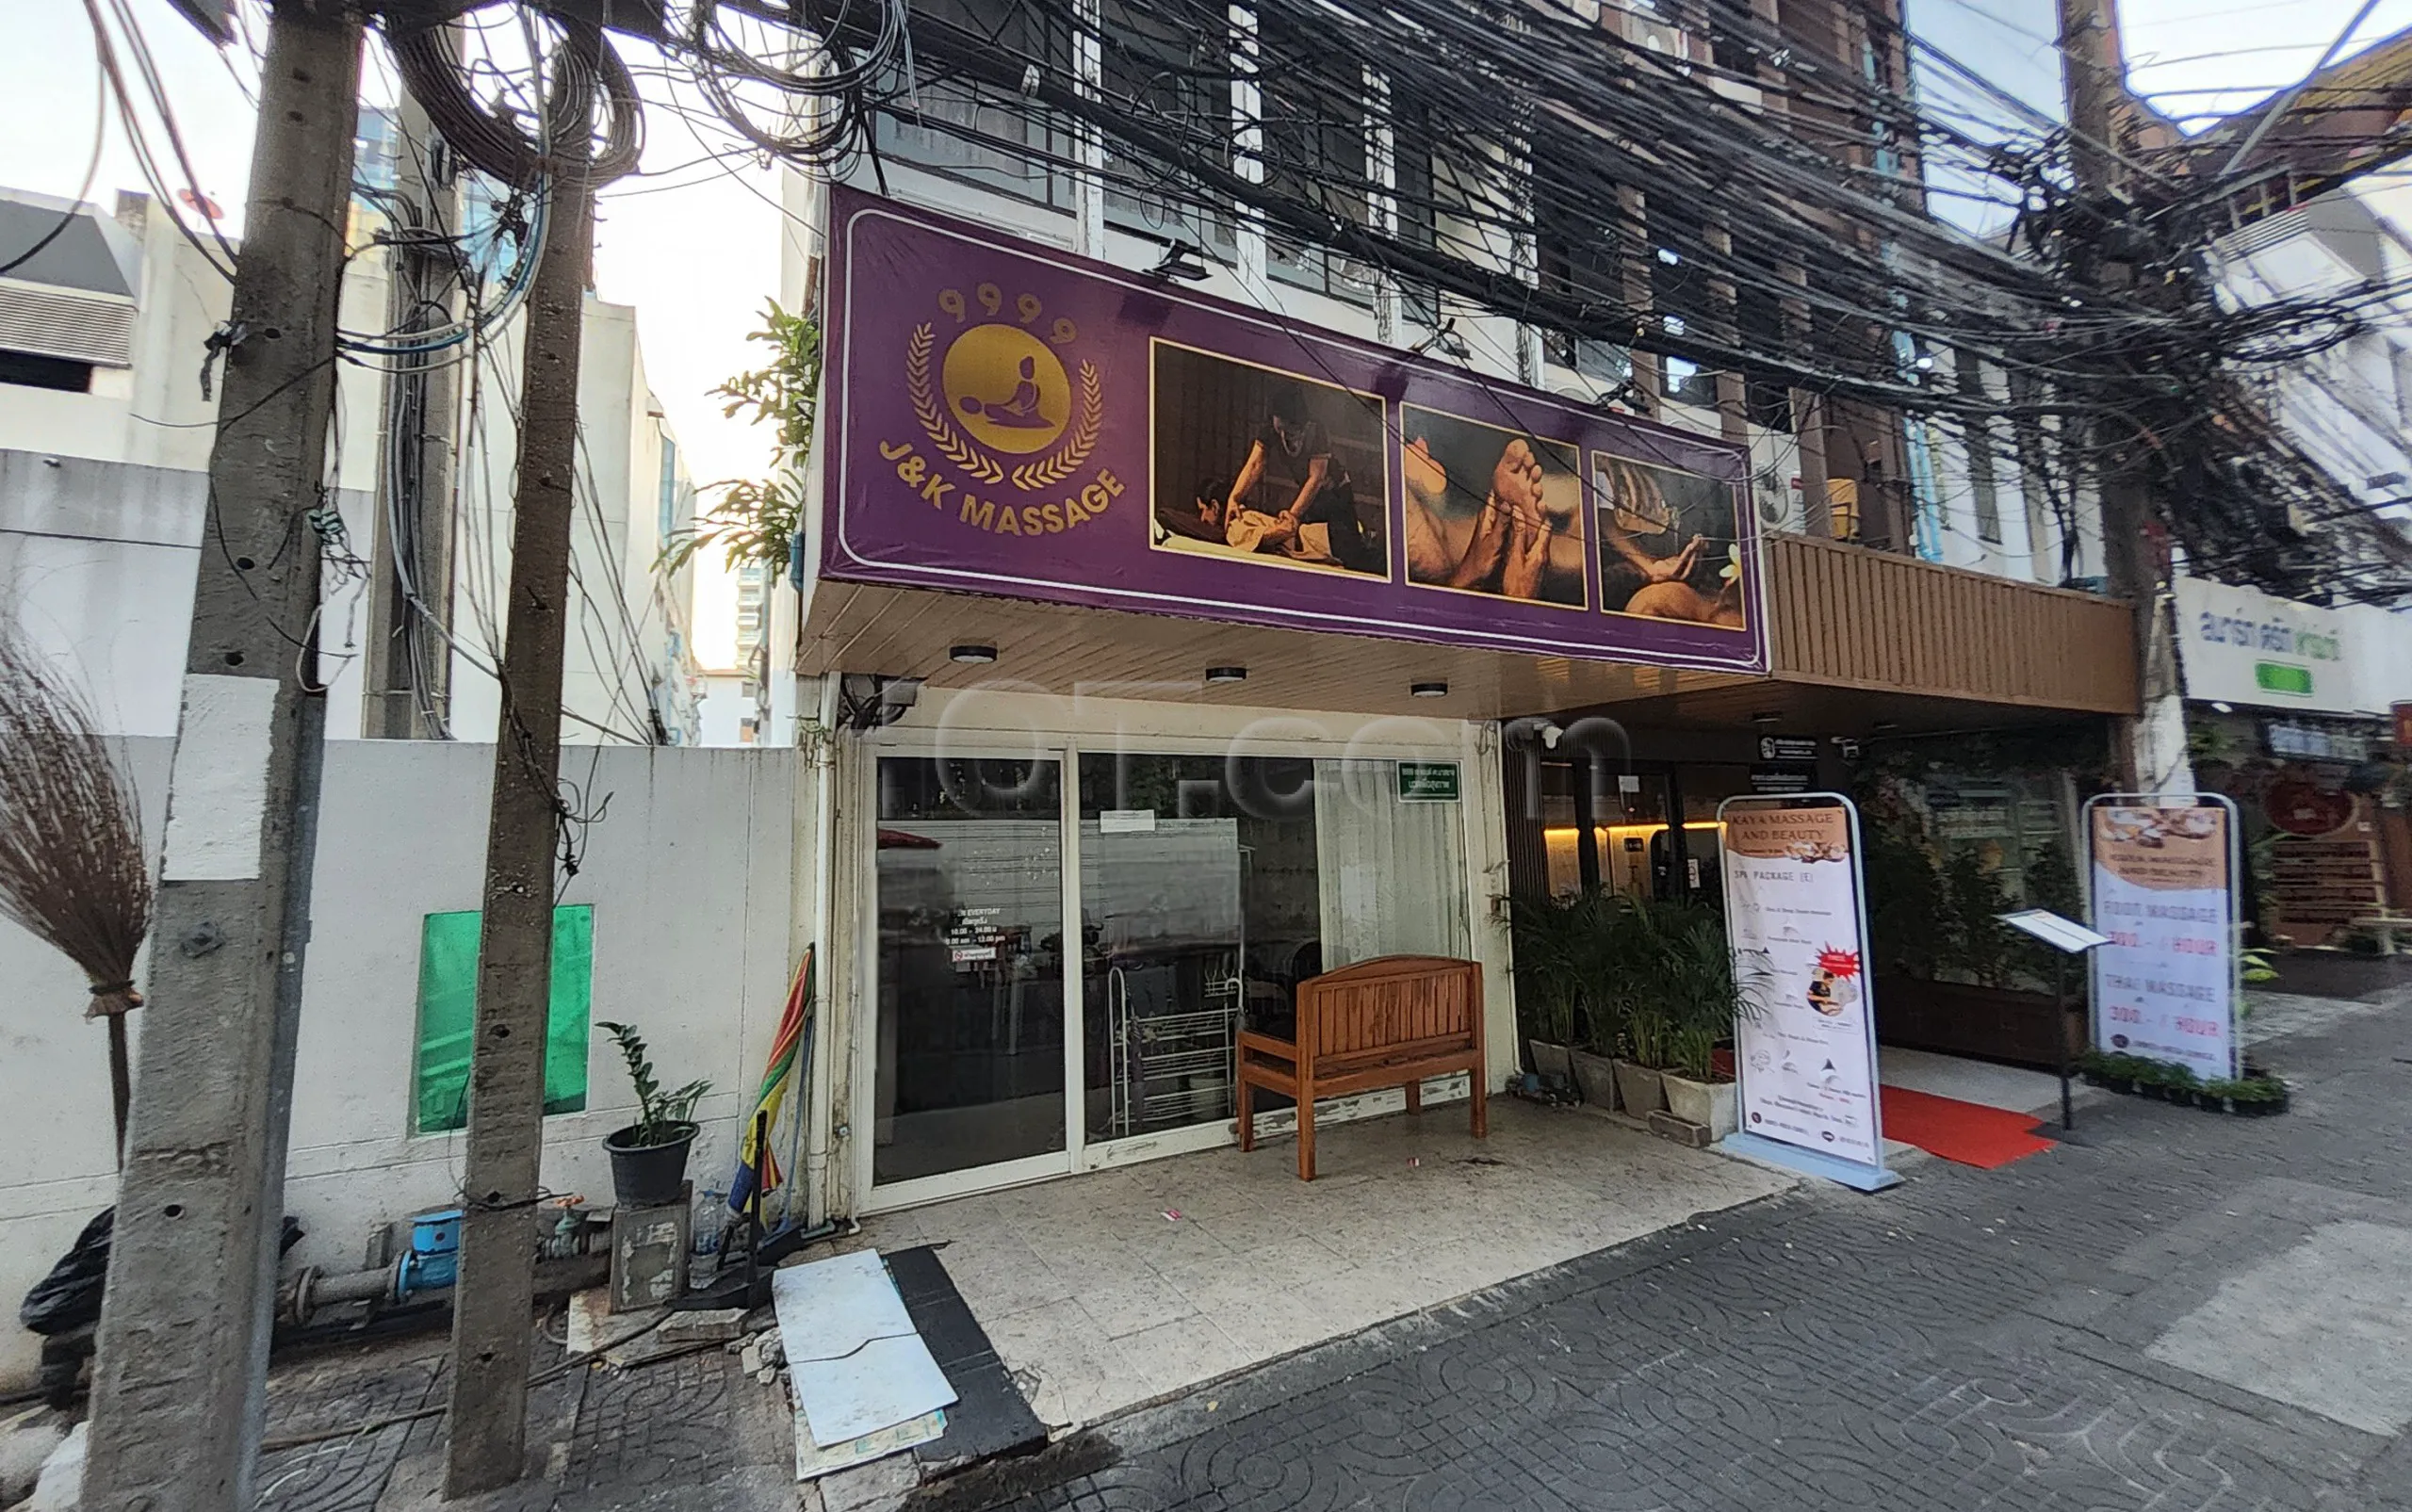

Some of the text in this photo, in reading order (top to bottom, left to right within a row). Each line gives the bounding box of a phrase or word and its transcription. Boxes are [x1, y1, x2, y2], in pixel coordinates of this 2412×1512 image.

[937, 282, 1078, 345] 9999
[878, 439, 1126, 537] J&K MASSAGE
[1768, 812, 1834, 824] MASSAGE
[1741, 829, 1825, 841] AND BEAUTY
[1753, 870, 1795, 882] PACKAGE
[968, 908, 1000, 917] EVERYDAY
